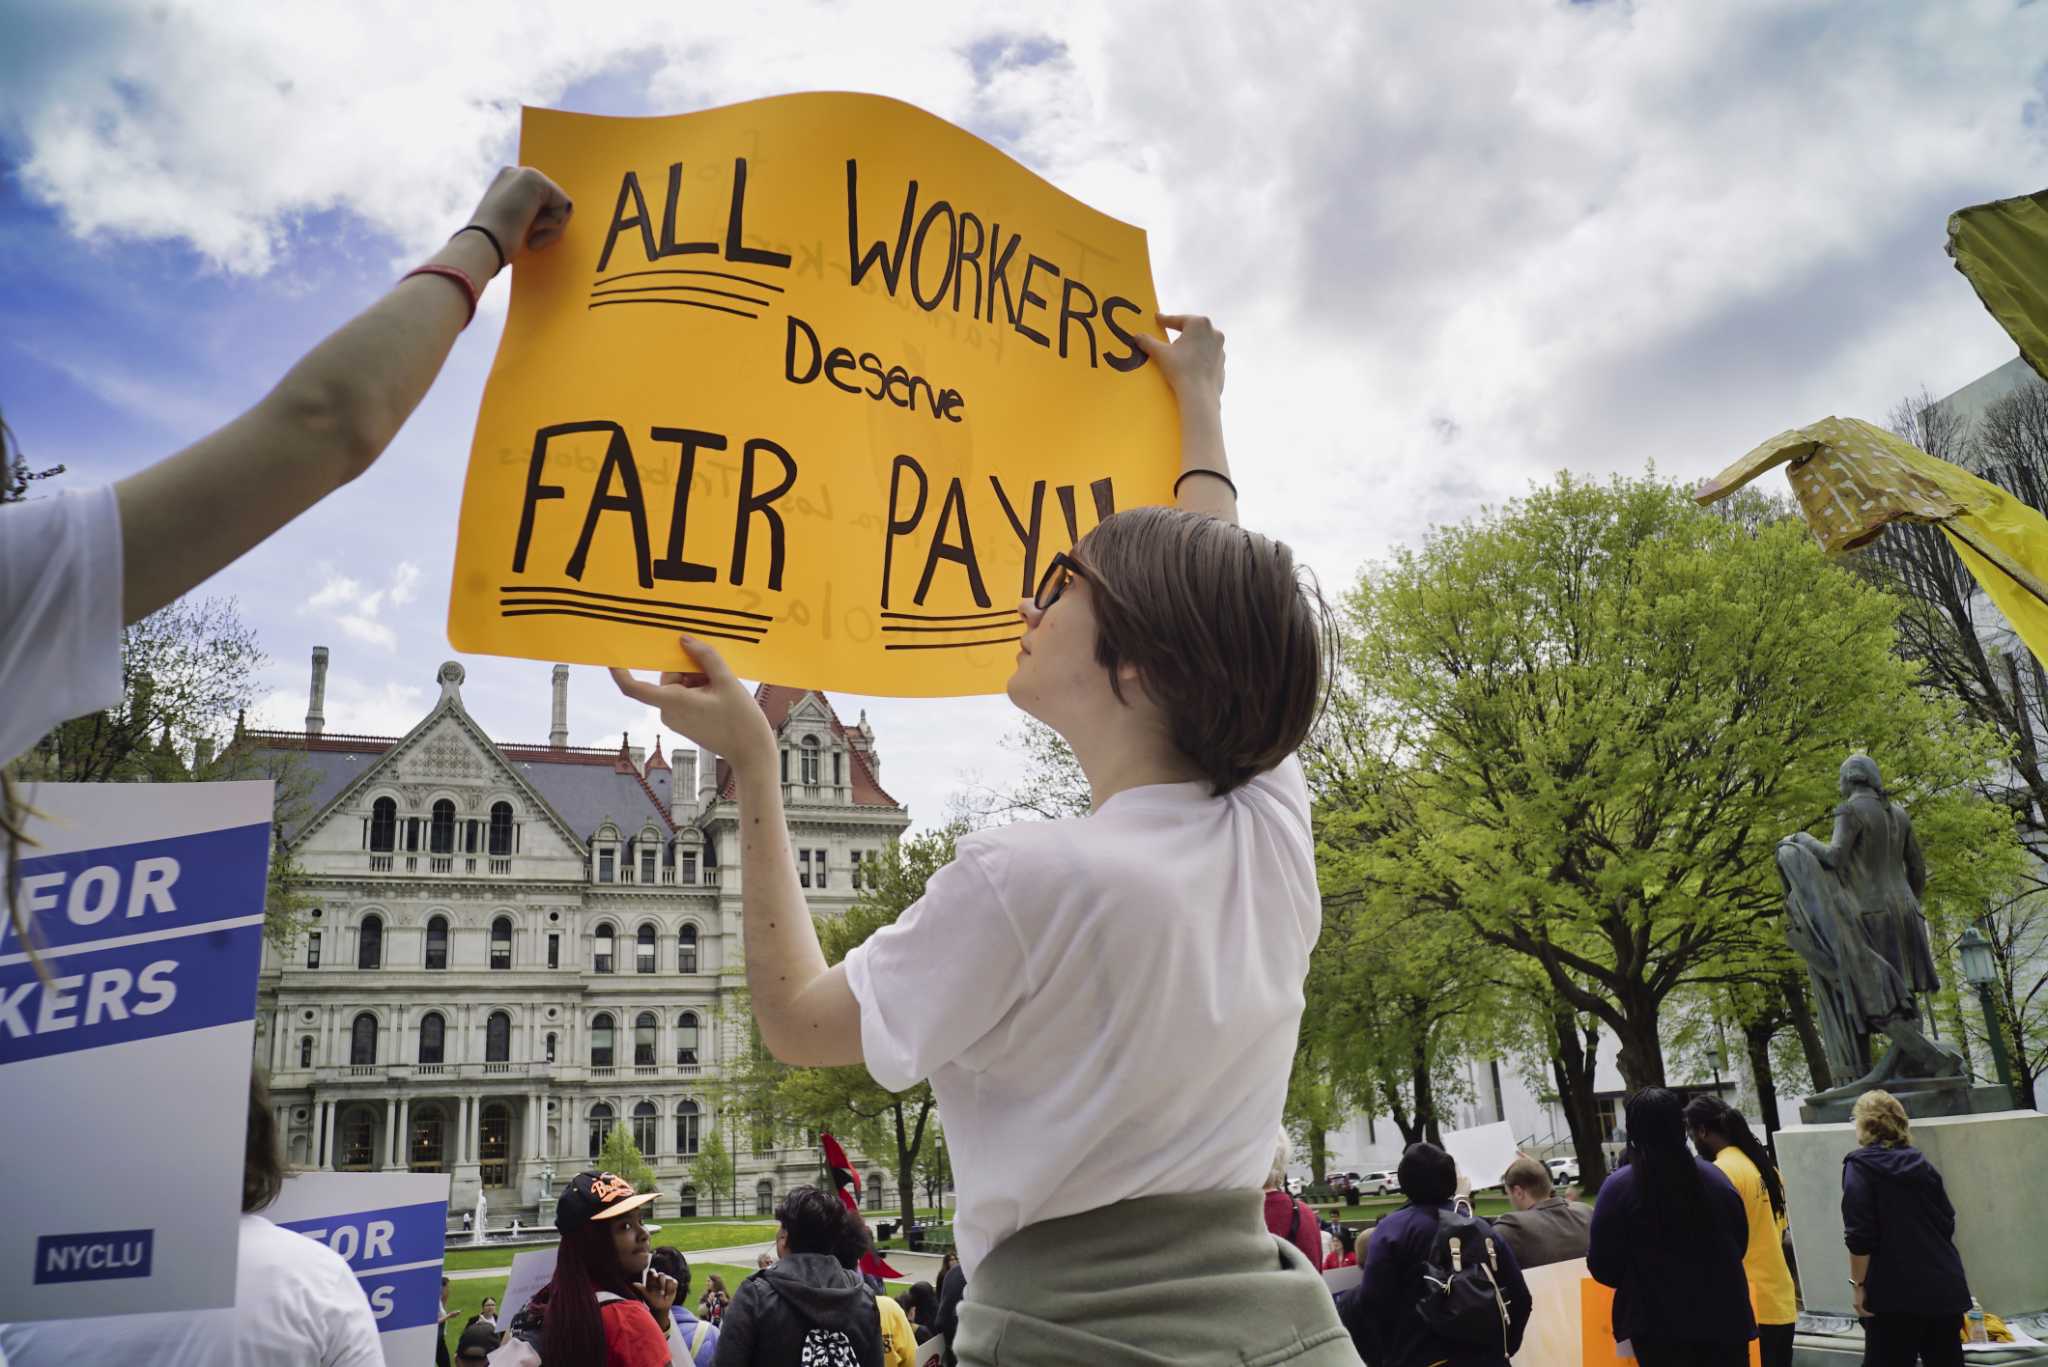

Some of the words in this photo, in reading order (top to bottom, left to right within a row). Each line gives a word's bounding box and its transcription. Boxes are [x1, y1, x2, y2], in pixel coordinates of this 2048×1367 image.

[595, 156, 791, 272] ALL
[846, 158, 1149, 373] WORKERS
[785, 315, 965, 423] Deserve
[511, 420, 799, 591] FAIR
[880, 455, 1115, 609] PAY!
[8, 856, 181, 937] FOR
[45, 1241, 144, 1272] NYCLU
[301, 1220, 395, 1262] OR
